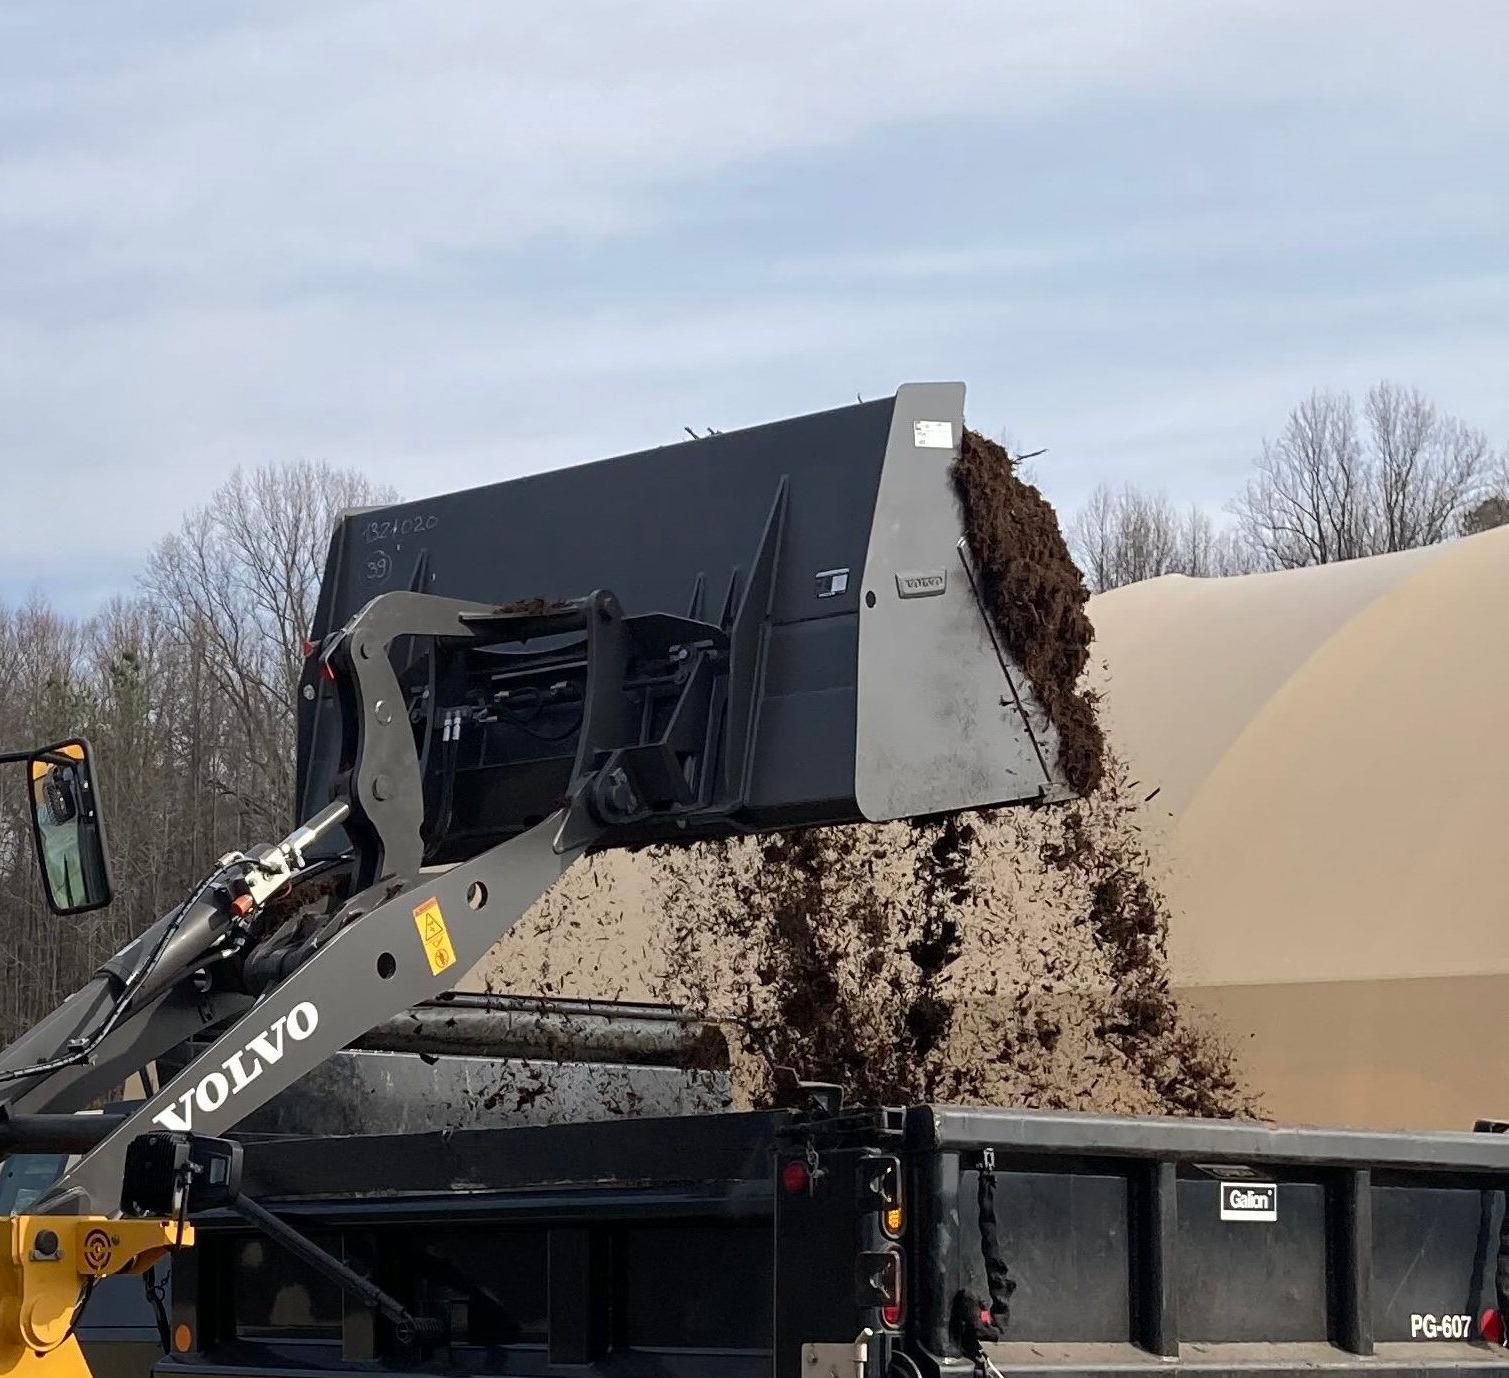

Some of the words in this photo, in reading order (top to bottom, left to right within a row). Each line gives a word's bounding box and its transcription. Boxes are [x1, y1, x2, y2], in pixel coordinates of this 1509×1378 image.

[152, 1001, 319, 1132] VOLVO
[1229, 1189, 1269, 1209] Galion
[1410, 1314, 1472, 1338] PG-607
